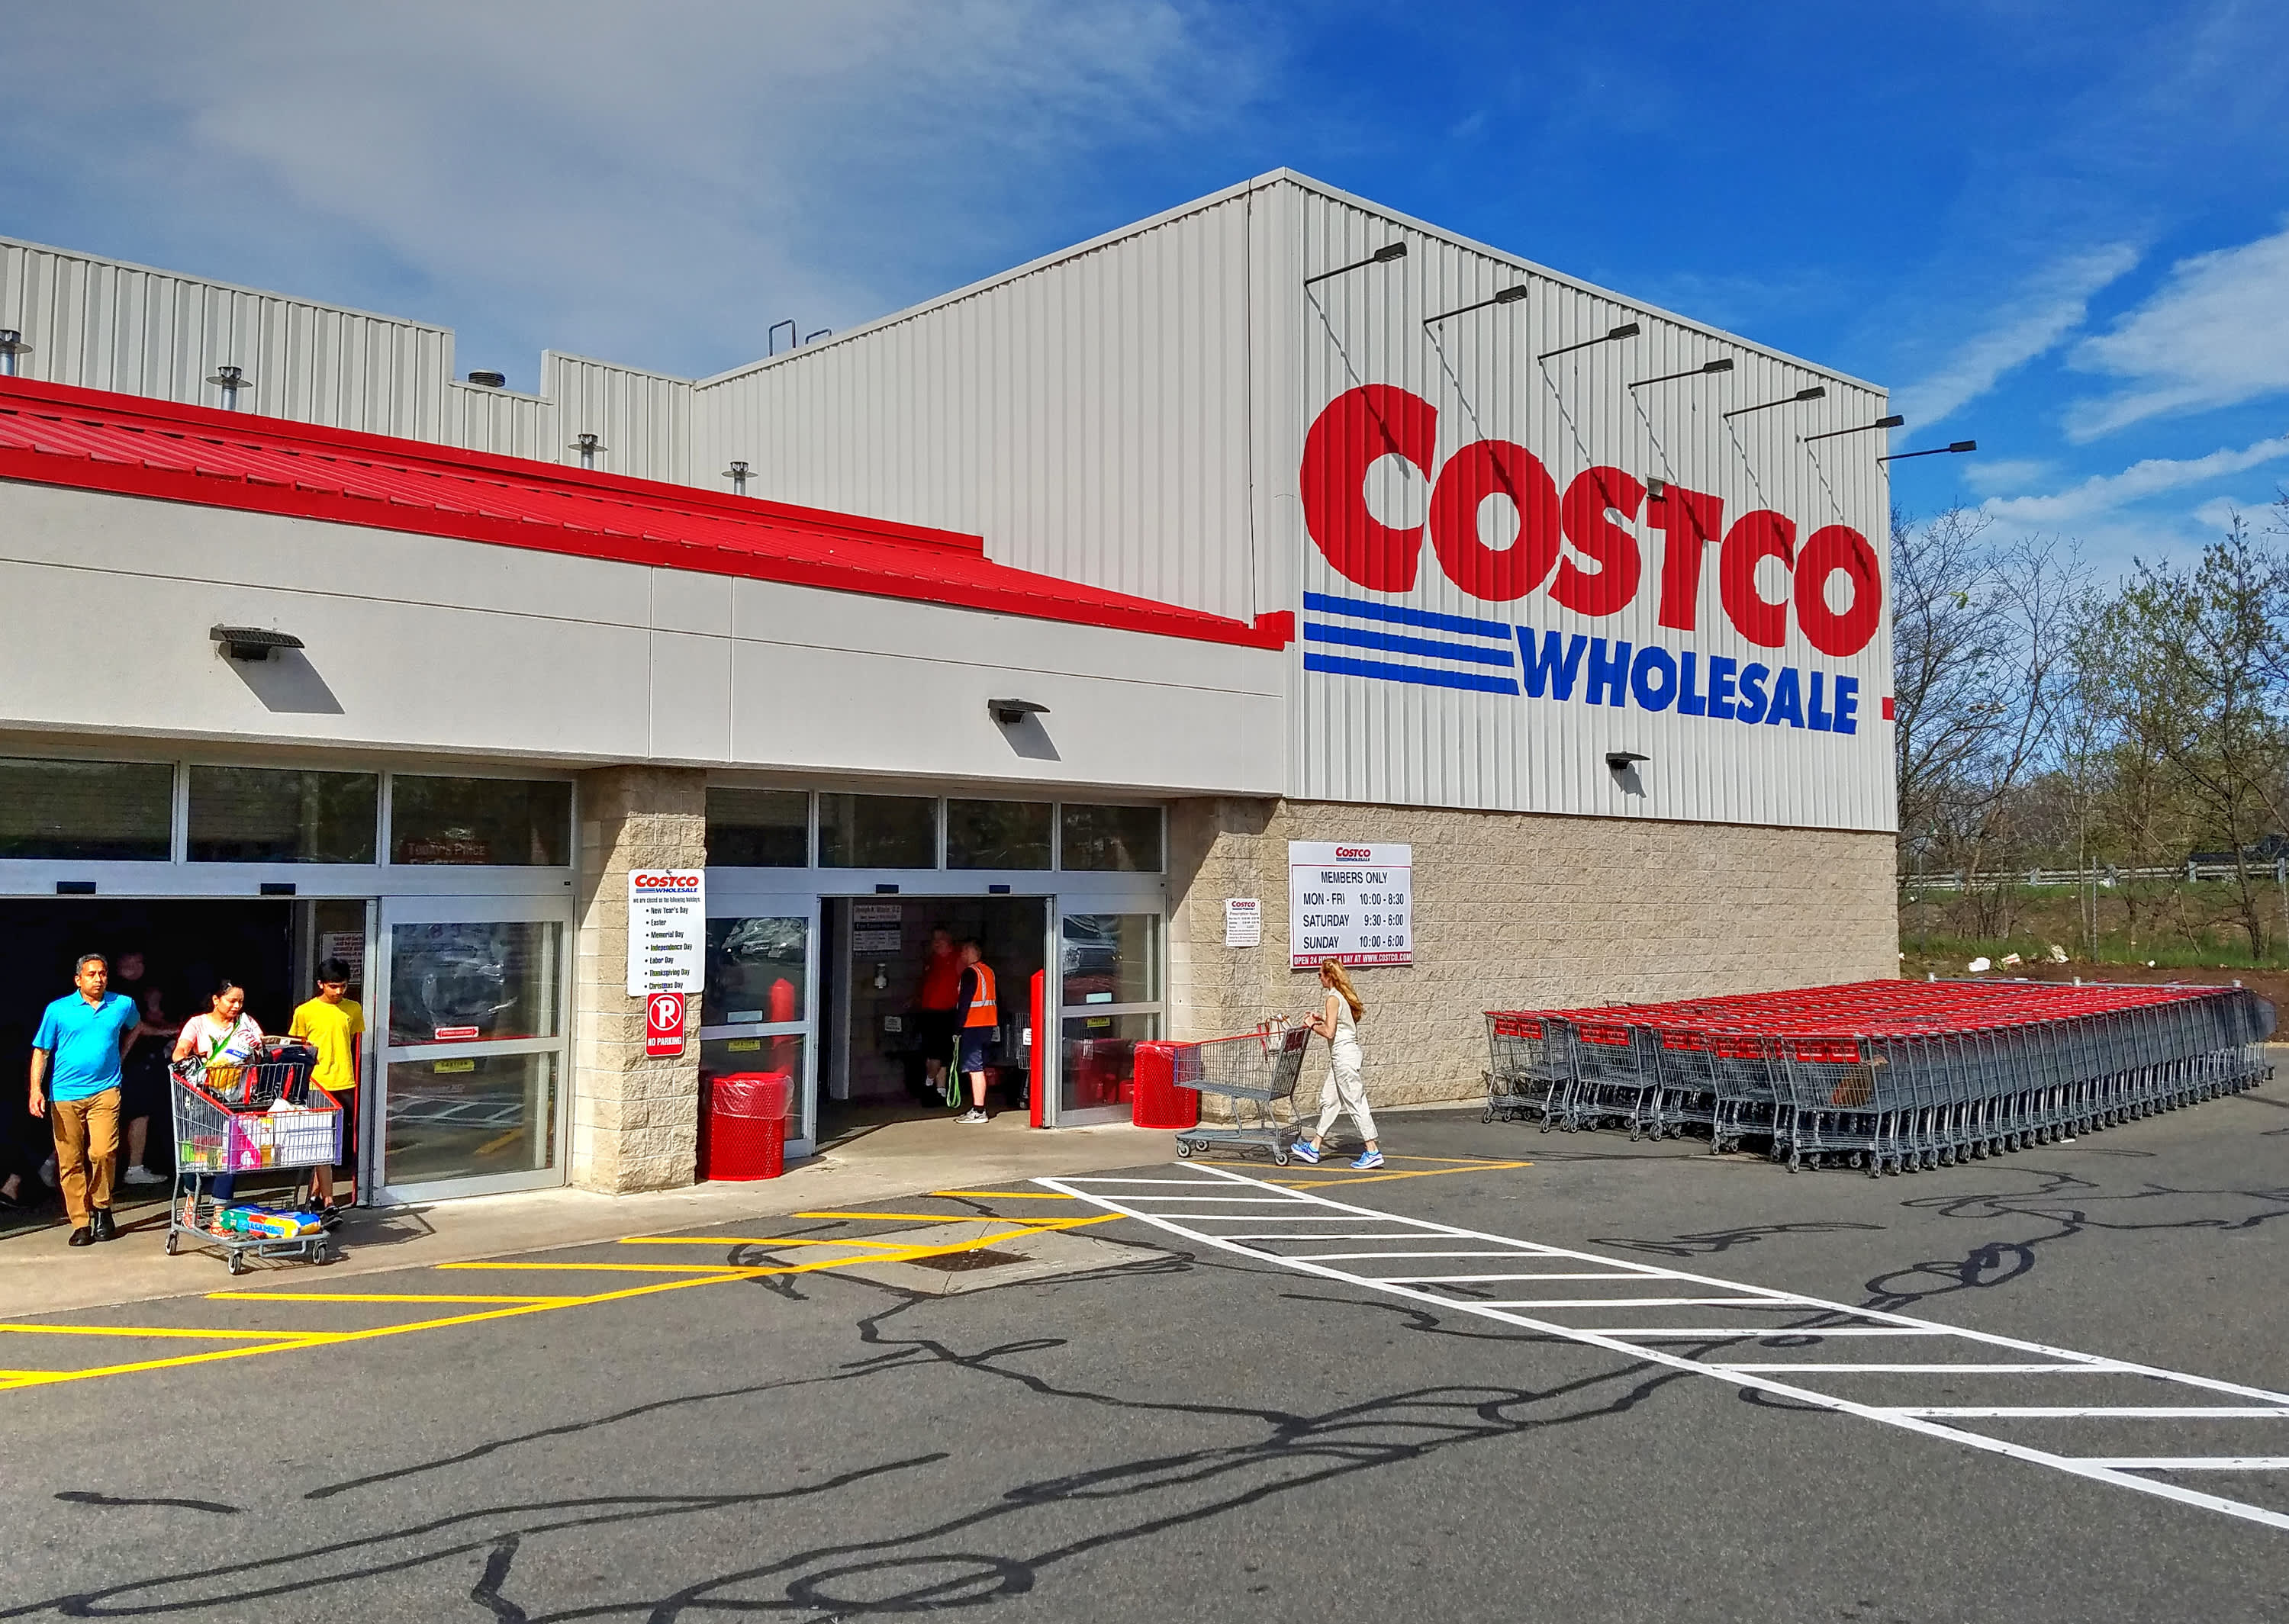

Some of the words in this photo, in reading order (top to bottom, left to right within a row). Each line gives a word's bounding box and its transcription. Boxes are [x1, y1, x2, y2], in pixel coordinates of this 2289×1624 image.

[1300, 384, 1882, 657] COSTCO
[1517, 625, 1859, 735] WHOLESALE
[1336, 847, 1371, 857] COSTCO
[635, 874, 699, 887] COSTCO
[1321, 871, 1363, 883] MEMBERS
[1366, 872, 1388, 883] ONLY
[1303, 892, 1325, 905] MON
[1331, 893, 1345, 905] FRI
[1360, 893, 1381, 905] 10:00
[1388, 893, 1404, 905] 8:30
[680, 906, 688, 915] Day
[1303, 915, 1349, 927] SATURDAY
[1364, 915, 1381, 926] 9:30
[1388, 915, 1403, 926] 6:00
[675, 931, 684, 939] Day
[684, 943, 692, 951] Day
[1303, 936, 1339, 949] SUNDAY
[1360, 935, 1381, 947] 10:00
[1387, 935, 1404, 947] 6:00
[665, 957, 674, 965] Day
[1294, 957, 1309, 965] OPEN
[1363, 953, 1411, 962] WWW.COSTCO.COM
[648, 1037, 655, 1047] NO
[657, 1036, 681, 1046] PARKING
